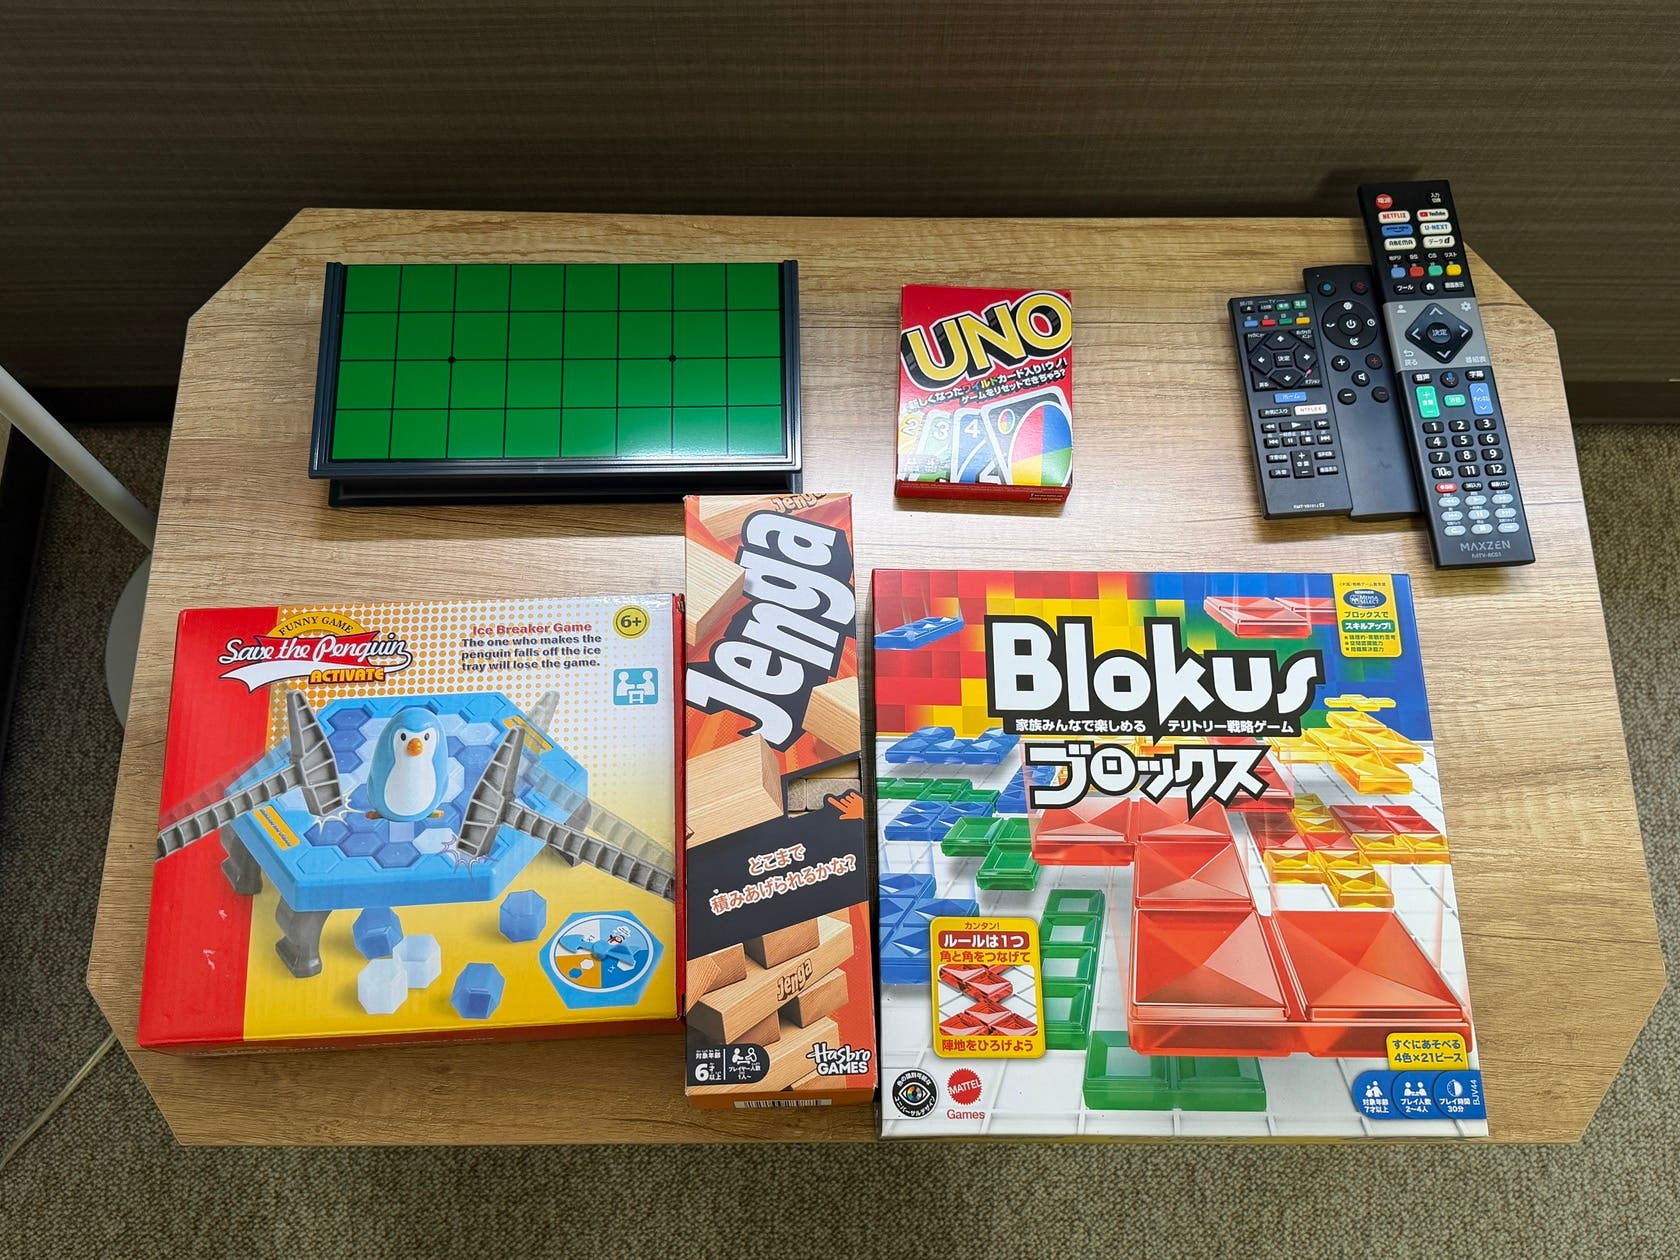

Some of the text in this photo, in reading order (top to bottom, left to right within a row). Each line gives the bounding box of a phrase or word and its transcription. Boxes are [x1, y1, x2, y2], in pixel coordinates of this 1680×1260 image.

[1382, 212, 1407, 220] NETFLIX
[901, 291, 1072, 391] UNO
[902, 418, 920, 436] 2
[934, 421, 950, 440] 3
[963, 419, 981, 438] 4
[1432, 422, 1438, 432] 1
[1456, 421, 1464, 430] 2
[1484, 420, 1491, 428] 3
[1433, 437, 1441, 446] 4
[1460, 436, 1468, 444] 5
[1486, 434, 1494, 444] 6
[1436, 452, 1444, 461] 7
[1463, 450, 1471, 460] 8
[1490, 449, 1498, 458] 9
[1465, 466, 1476, 474] 11
[1490, 464, 1502, 474] 12
[1460, 540, 1512, 552] MAXZEN
[279, 615, 353, 636] FUNNY GAME
[620, 614, 642, 628] 6+
[1344, 622, 1392, 630] スキルアップ!
[472, 623, 592, 635] Ice Breaker Game
[686, 512, 857, 746] Jenga
[462, 634, 602, 648] The one who makes the
[218, 633, 409, 664] Save the Penguin
[461, 645, 602, 661] penguin falls off the ice
[461, 658, 601, 673] tray will lose the game.
[987, 618, 1322, 725] Blokus
[309, 667, 386, 685] ACTIVATE
[1015, 718, 1295, 733] 家族みんなで楽しめる テリトリー戦略ゲーム
[1028, 743, 1268, 812] ブロックス
[749, 843, 806, 876] どこまで
[709, 854, 857, 915] 積みあげられるかな?
[964, 922, 1000, 930] カンタン!
[944, 934, 1025, 948] ルールは1つ
[940, 951, 1031, 963] 角と角をつなげて
[776, 958, 813, 1001] Jenga
[941, 1039, 1034, 1052] 陣地をひろげよう
[1392, 1039, 1461, 1050] すぐにあそべる
[806, 1042, 871, 1065] Hasbro
[1394, 1052, 1463, 1063] 4色×21ピース
[695, 1064, 710, 1081] 6
[816, 1062, 869, 1075] GAMES
[949, 1079, 983, 1095] MATTEL
[1470, 1080, 1481, 1105] BJV44
[946, 1109, 986, 1120] Games
